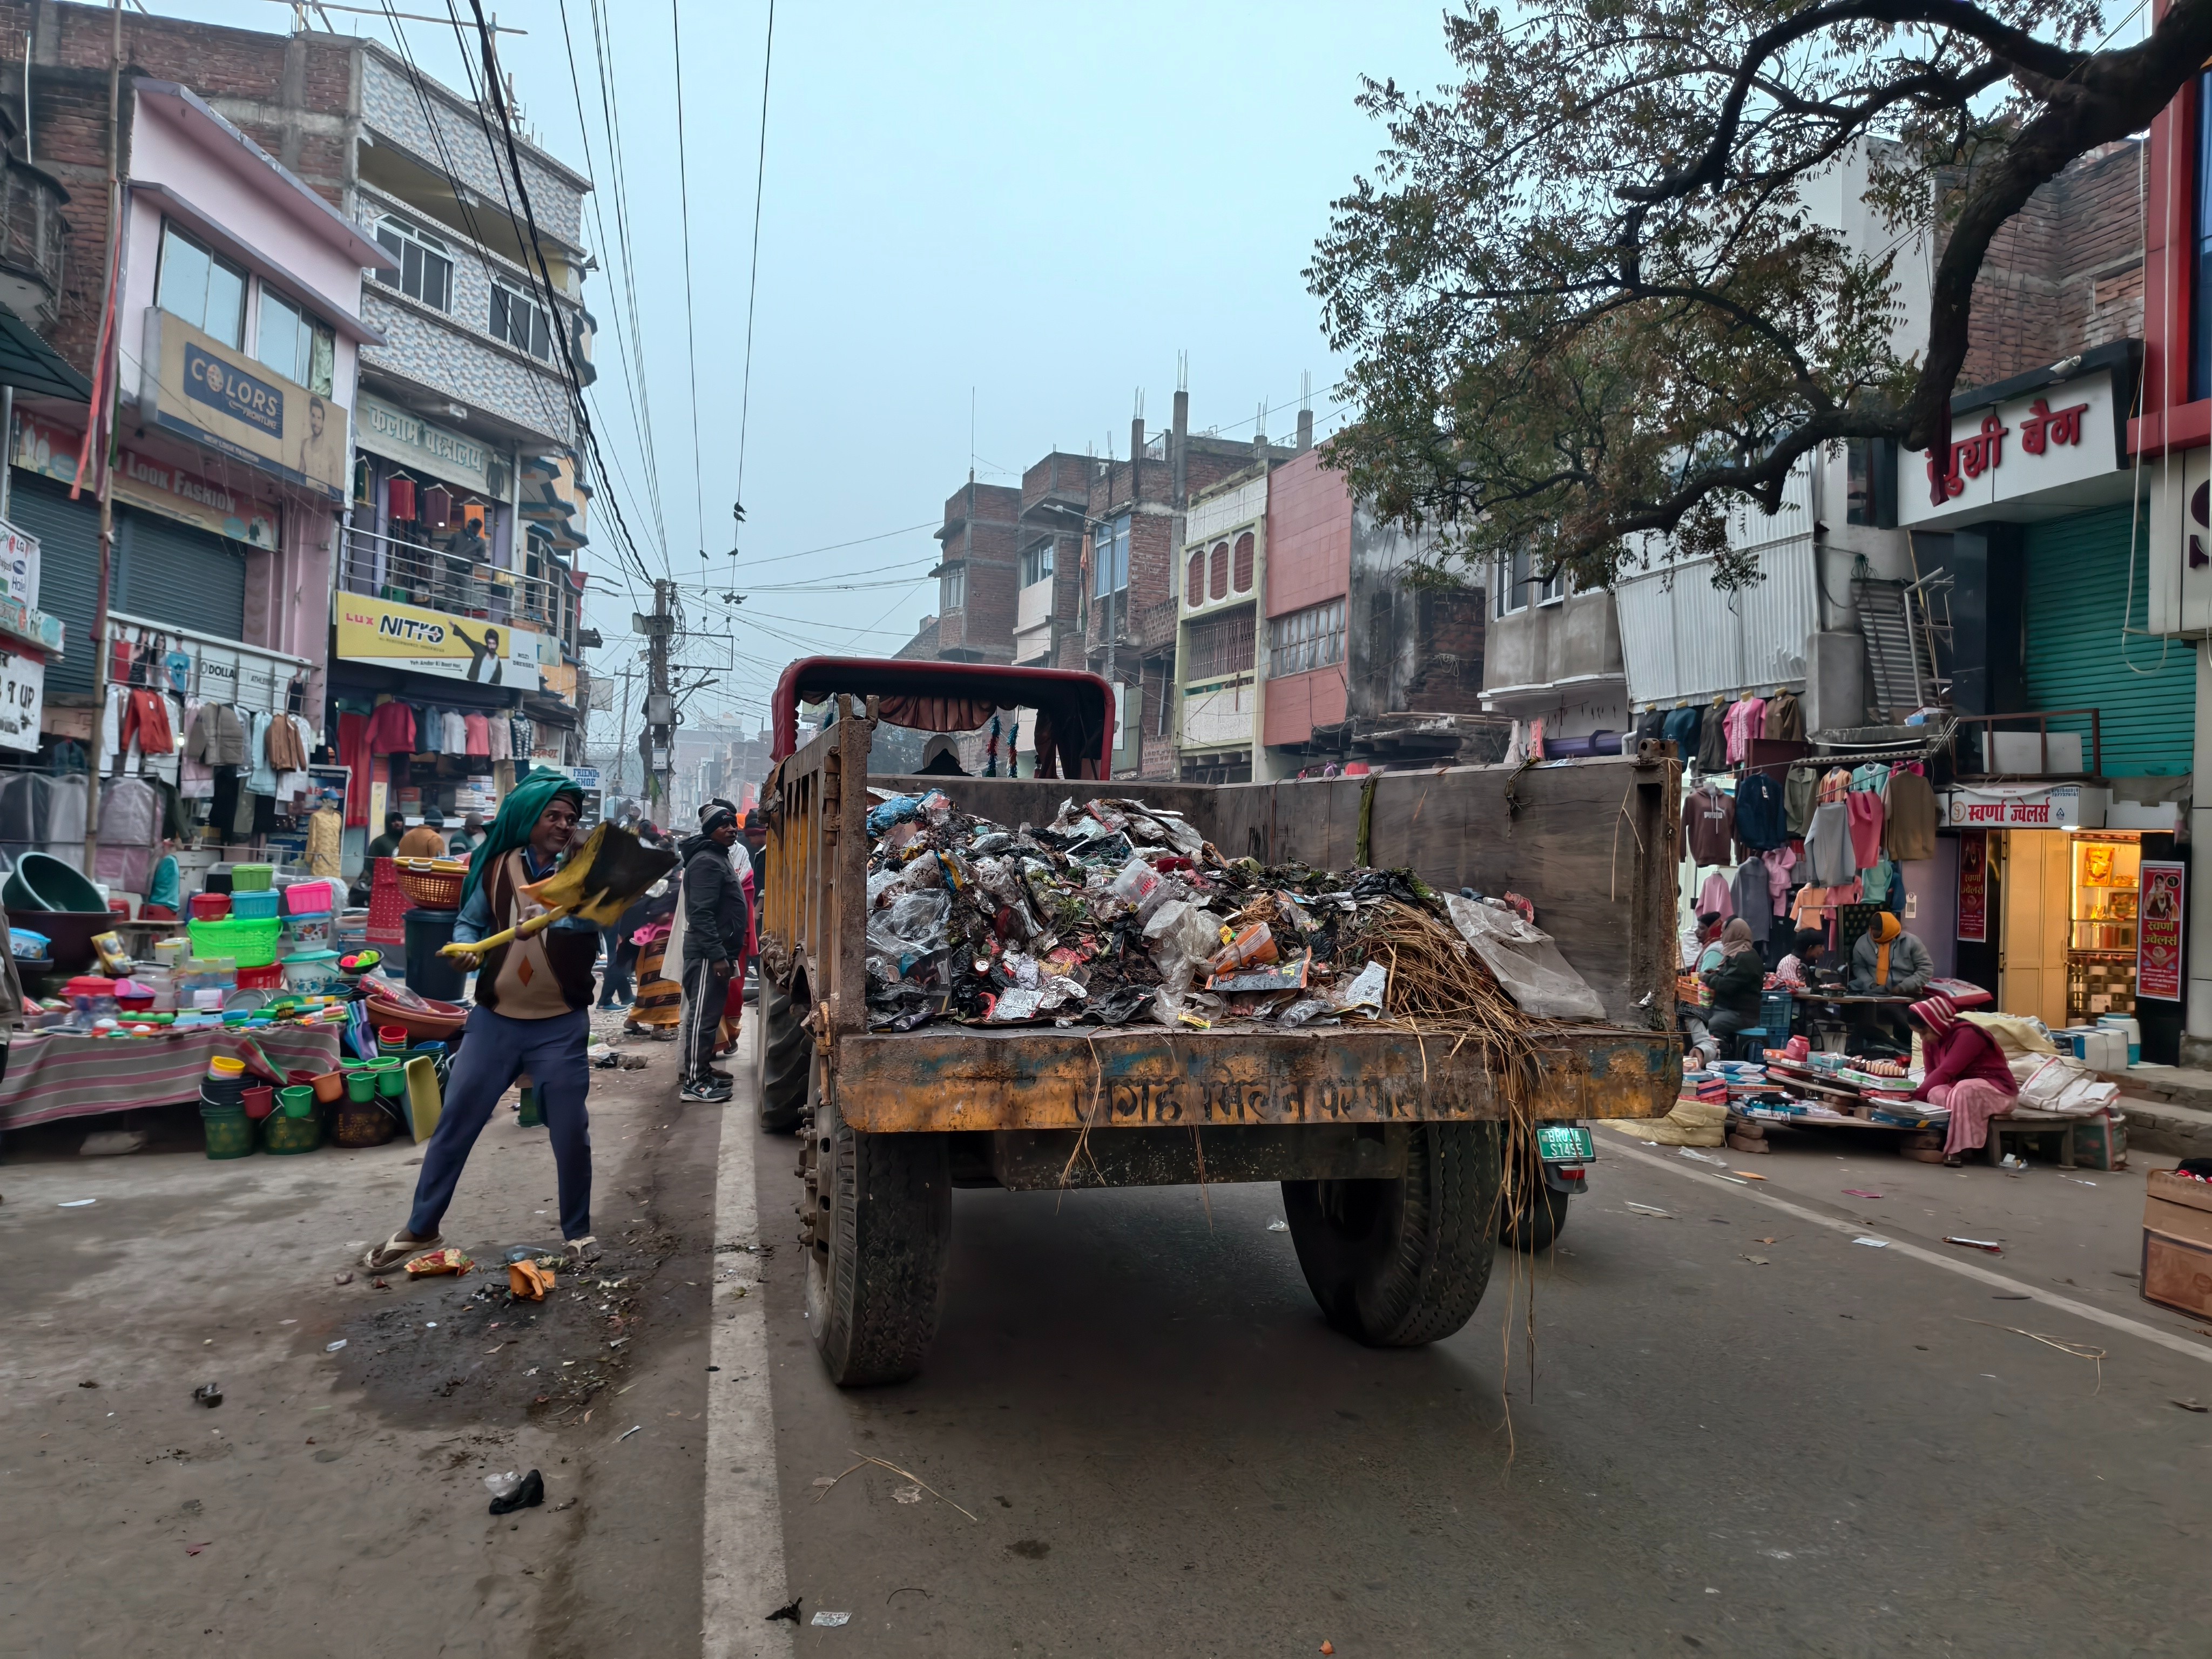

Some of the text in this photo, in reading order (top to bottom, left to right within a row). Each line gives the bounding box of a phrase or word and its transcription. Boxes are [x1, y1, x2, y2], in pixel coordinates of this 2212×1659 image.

[192, 358, 278, 417] COLORS
[173, 469, 235, 514] FASHION
[346, 612, 374, 625] LUX
[379, 615, 444, 643] NITRO
[209, 665, 238, 679] DOLLA
[576, 778, 596, 787] SHOE
[2010, 797, 2051, 822] ज्वेलर्स
